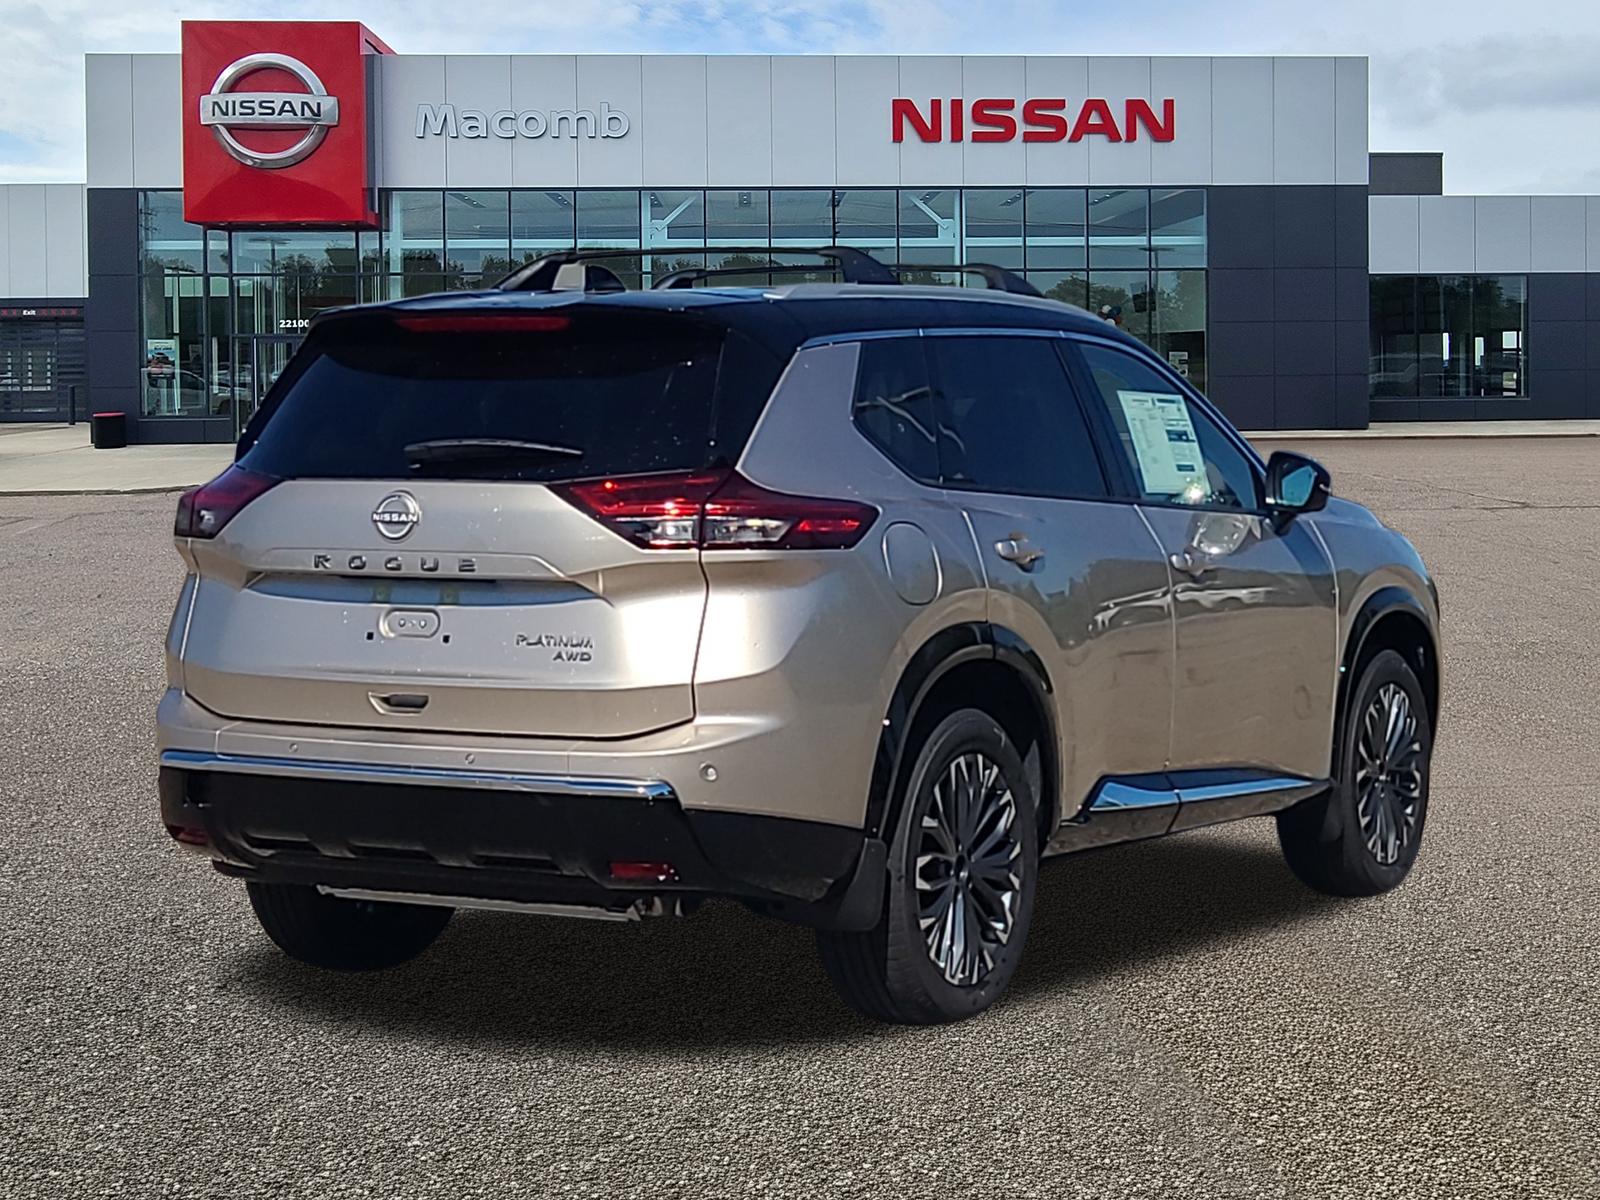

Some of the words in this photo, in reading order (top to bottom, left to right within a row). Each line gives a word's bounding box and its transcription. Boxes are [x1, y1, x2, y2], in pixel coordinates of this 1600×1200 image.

[211, 100, 322, 118] NISSAN
[414, 102, 630, 139] Macomb
[892, 98, 1175, 143] NISSAN
[279, 319, 309, 328] 22100
[373, 512, 418, 522] NISSAN
[313, 554, 477, 573] ROGUE
[516, 634, 593, 649] PLATINUM
[552, 650, 592, 662] AWD
